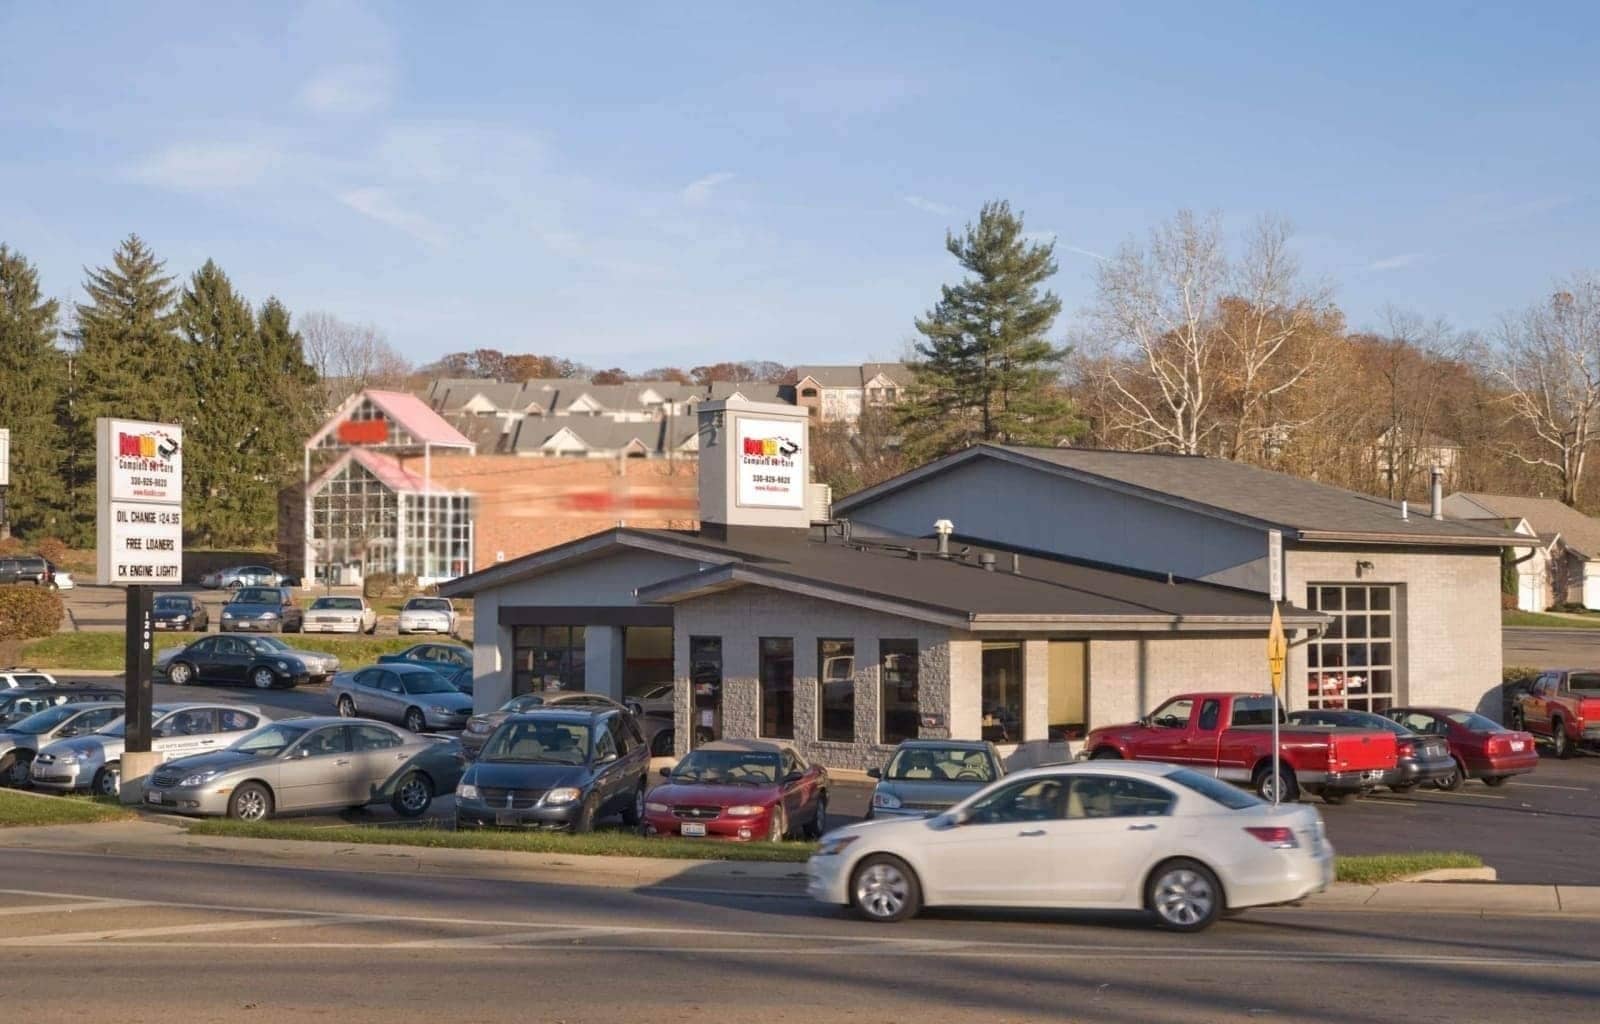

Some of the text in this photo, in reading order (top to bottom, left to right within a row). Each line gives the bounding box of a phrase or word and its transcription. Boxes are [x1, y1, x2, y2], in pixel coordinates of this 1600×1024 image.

[116, 510, 128, 522] OIL
[131, 511, 156, 523] CHANGE
[126, 538, 174, 550] FREE LOANERS
[118, 565, 128, 577] CK
[130, 565, 153, 577] ENGINE
